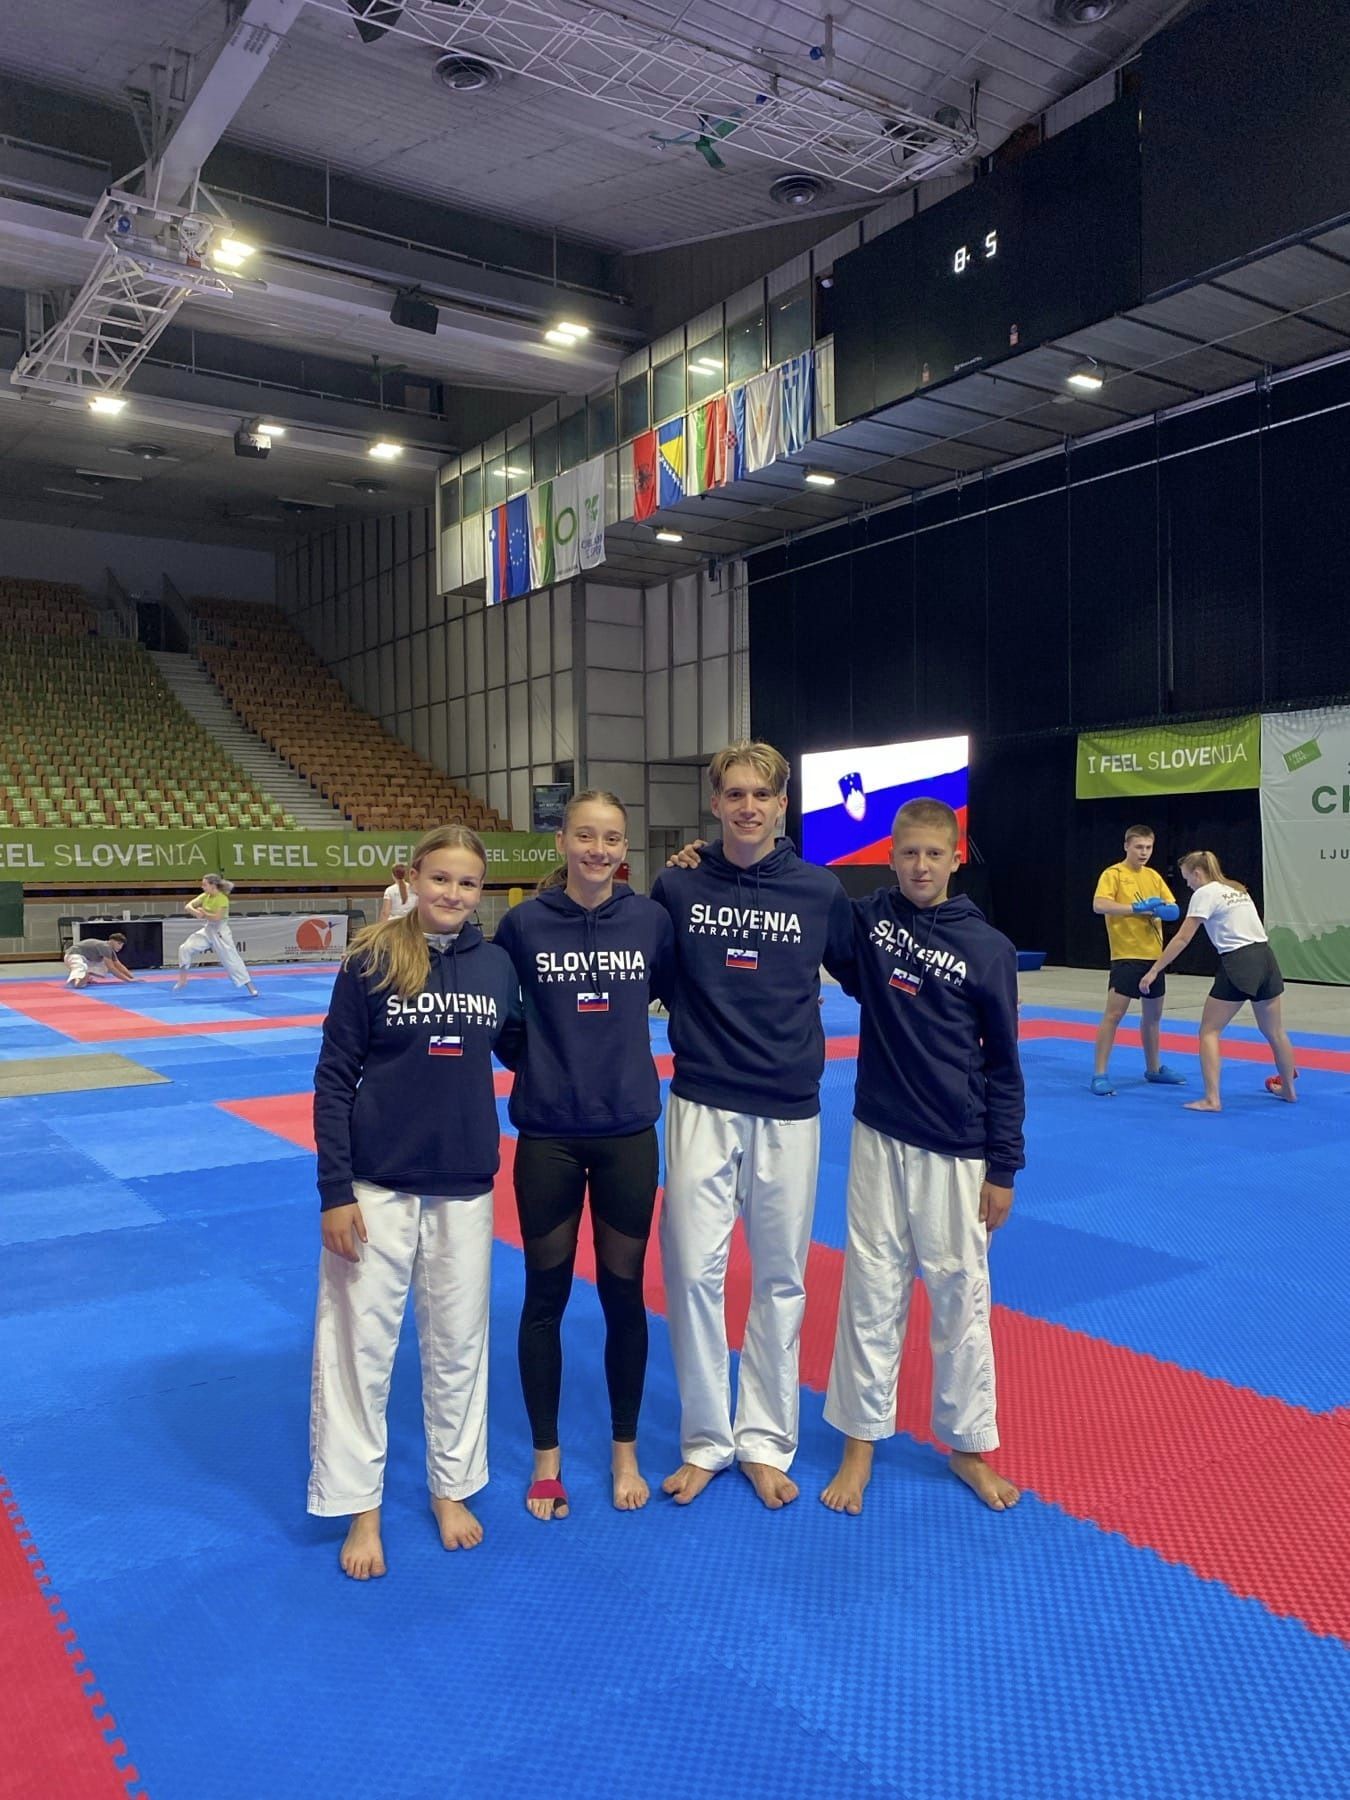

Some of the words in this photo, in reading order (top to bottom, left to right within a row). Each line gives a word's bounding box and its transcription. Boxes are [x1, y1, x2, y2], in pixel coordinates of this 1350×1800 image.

[1088, 756, 1096, 773] I
[1100, 754, 1143, 773] FEEL
[1148, 743, 1248, 770] SLOVENIA
[0, 843, 45, 867] EL
[54, 843, 207, 867] SLOVENIA
[233, 844, 245, 866] I
[252, 845, 318, 867] FEEL
[326, 845, 414, 867] SLOVE
[485, 849, 509, 862] EEL
[690, 903, 802, 934] SLOVENIA
[688, 924, 750, 939] KARATE
[761, 931, 801, 944] TEAM
[874, 919, 967, 979] SLOVENIA
[535, 950, 645, 973] SLOVENIA
[537, 972, 598, 983] KARATE
[609, 971, 645, 981] TEAM
[924, 963, 963, 986] TEAM
[386, 992, 498, 1019] SLOVENIA
[386, 1014, 455, 1027] KARATE
[466, 1014, 498, 1030] TEAM
